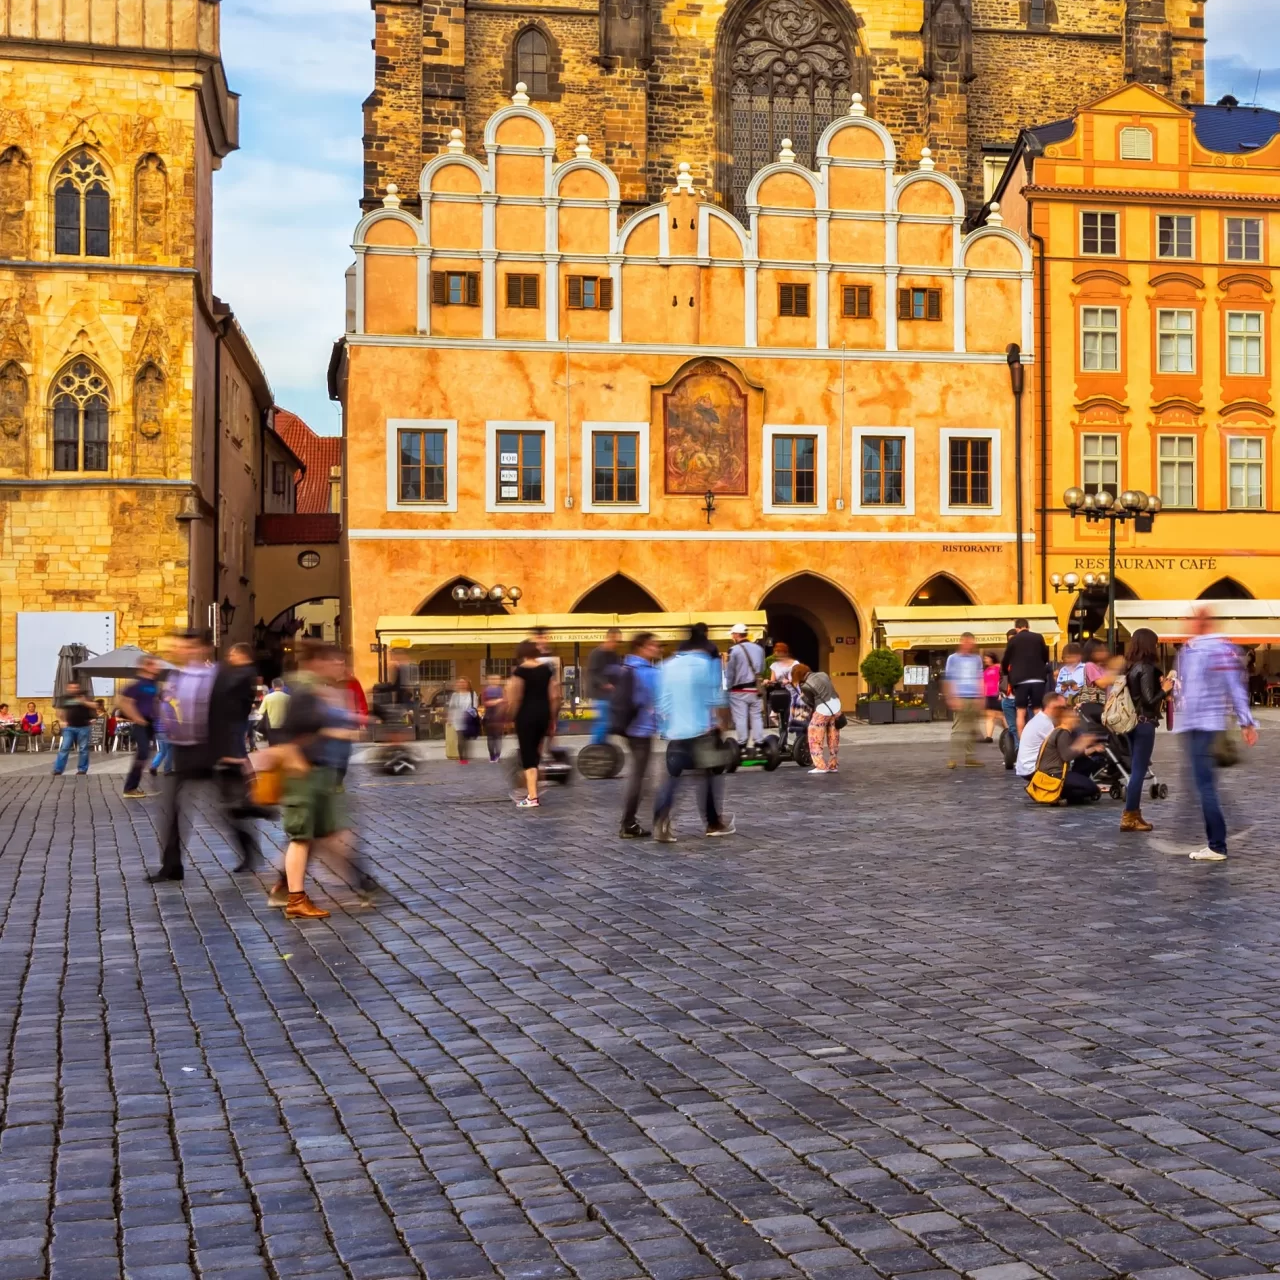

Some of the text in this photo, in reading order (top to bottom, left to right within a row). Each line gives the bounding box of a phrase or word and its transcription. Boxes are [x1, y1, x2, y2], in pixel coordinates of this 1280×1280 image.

[942, 544, 1003, 553] RISTORANTE
[1074, 557, 1217, 570] RESTAURANT CAFÉ
